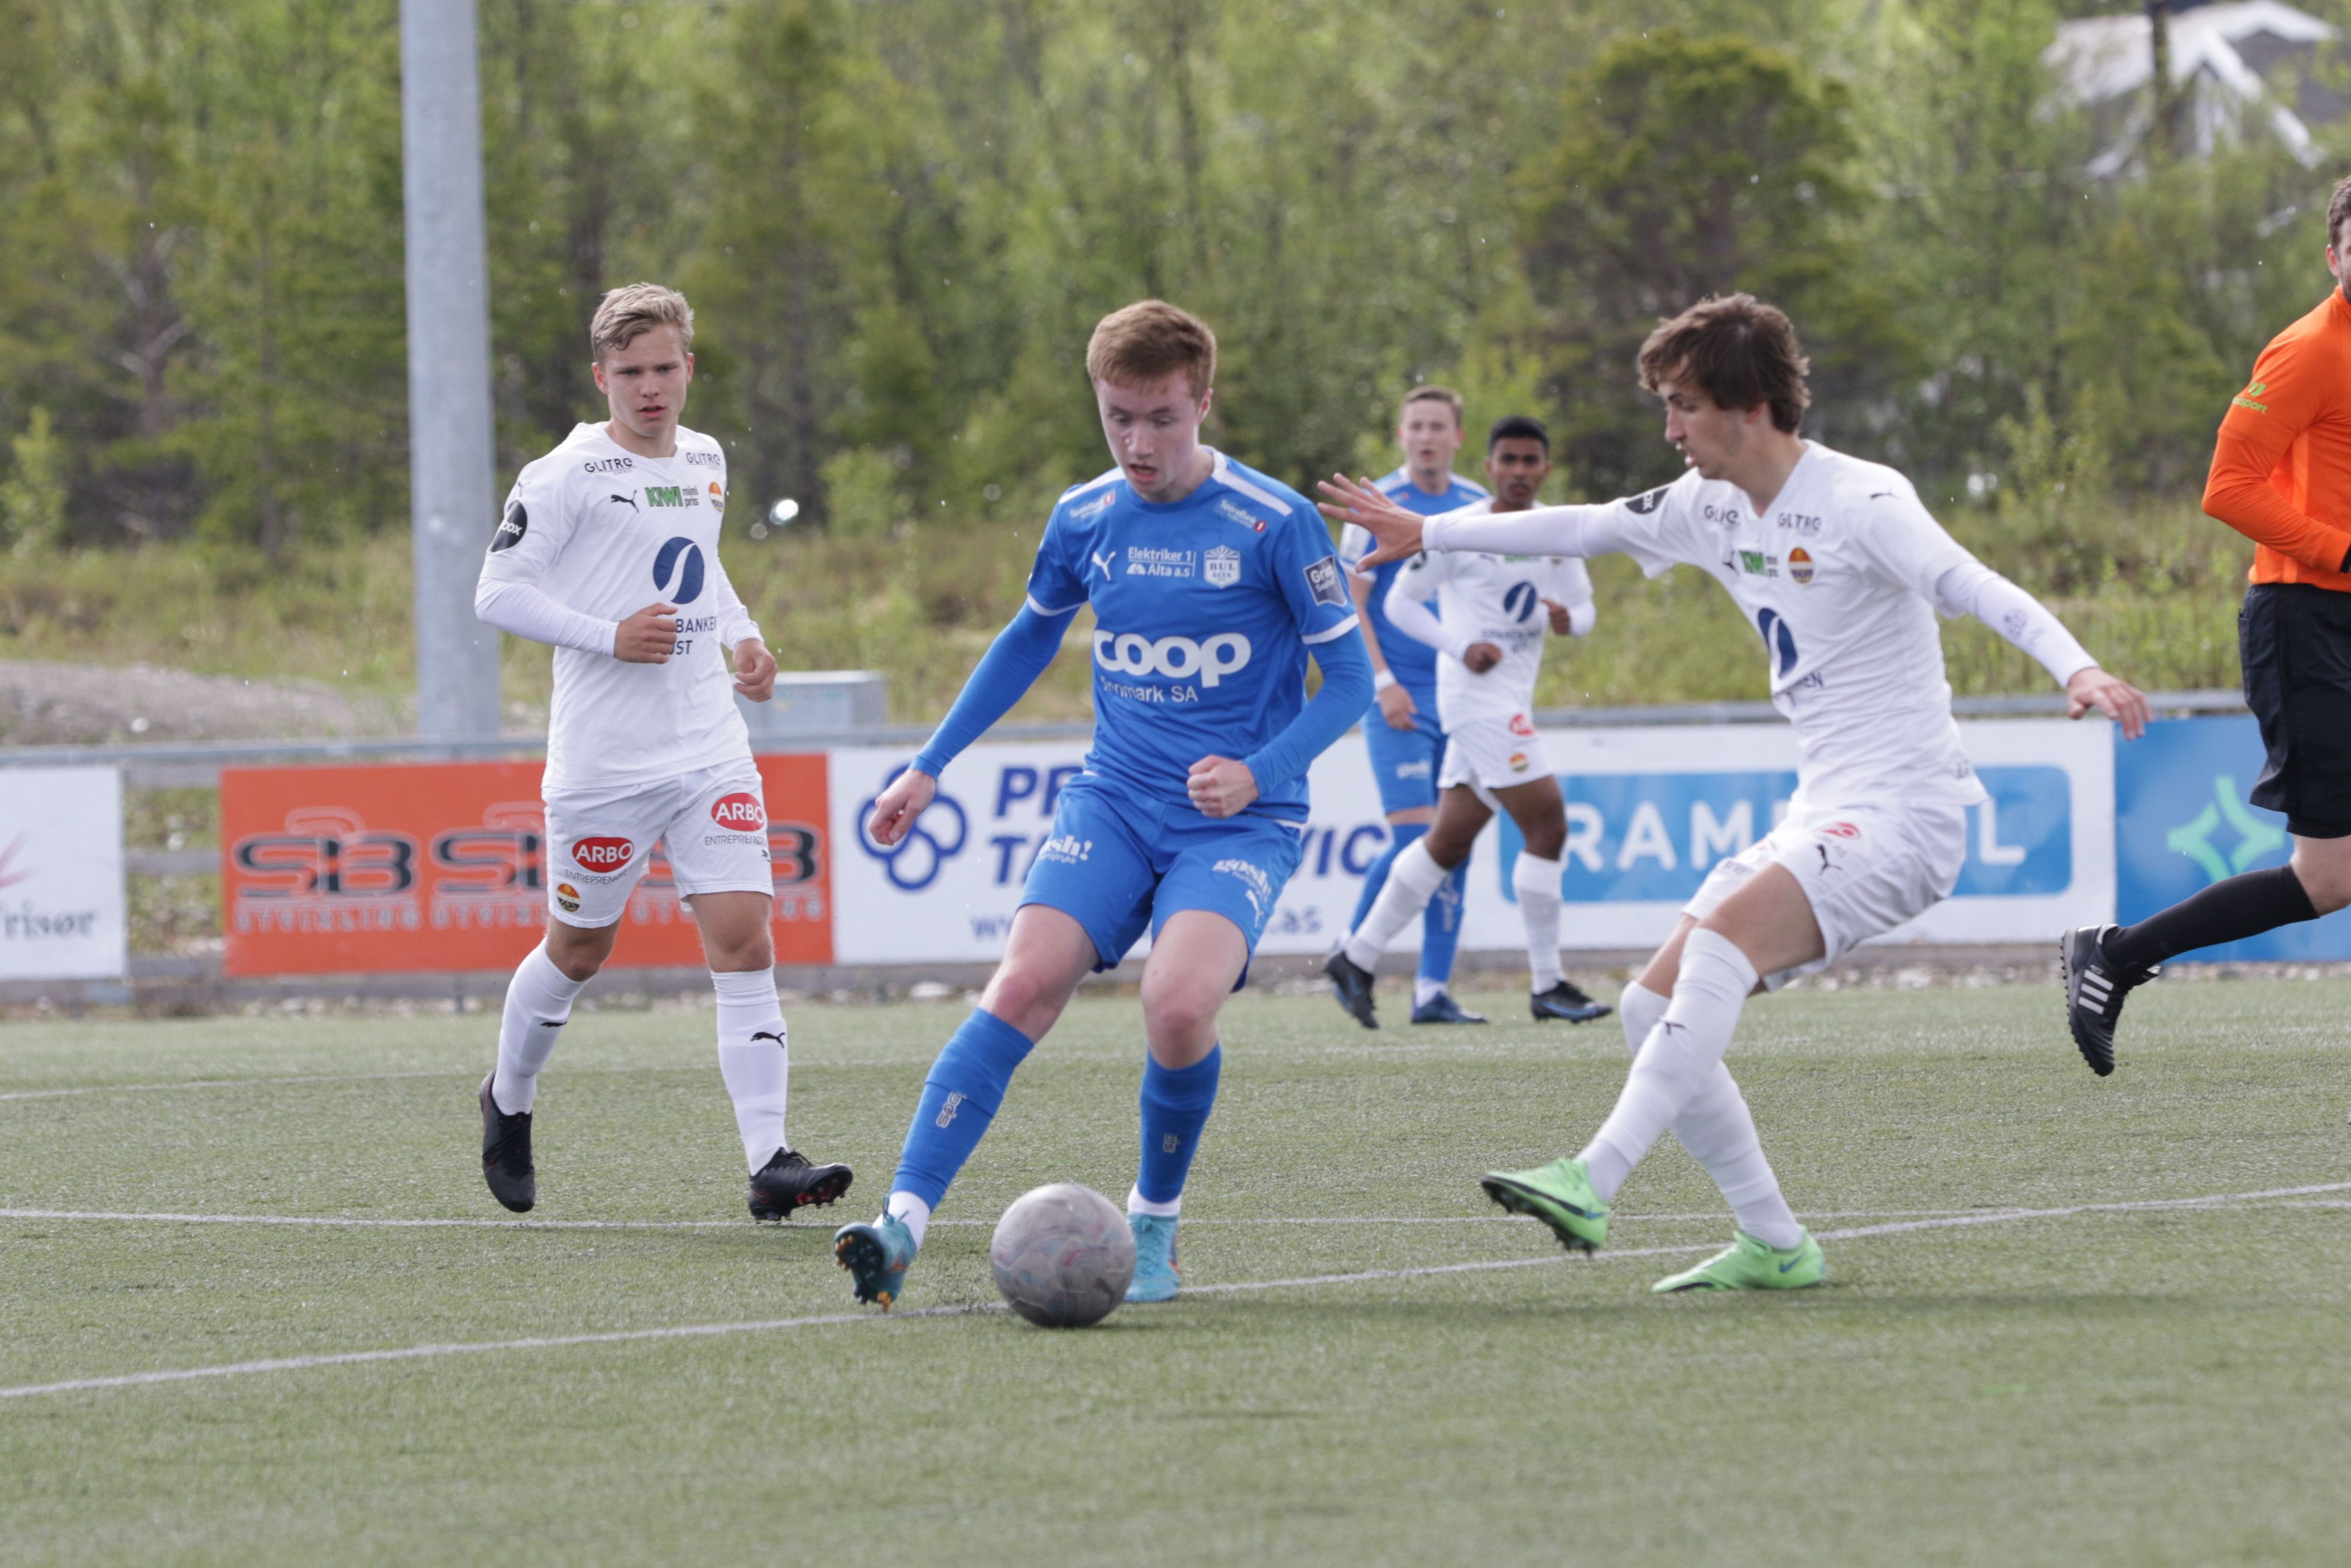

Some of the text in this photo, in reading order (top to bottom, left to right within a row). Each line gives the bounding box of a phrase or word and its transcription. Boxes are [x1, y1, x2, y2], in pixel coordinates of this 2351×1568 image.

[644, 486, 683, 507] KIWI
[683, 486, 698, 496] mini
[685, 497, 699, 508] pris
[1128, 547, 1182, 561] Elektriker
[1147, 563, 1172, 576] Alta
[1094, 629, 1251, 688] coop
[1171, 685, 1198, 703] SA
[715, 802, 764, 824] ARBO
[575, 843, 634, 863] ARBO
